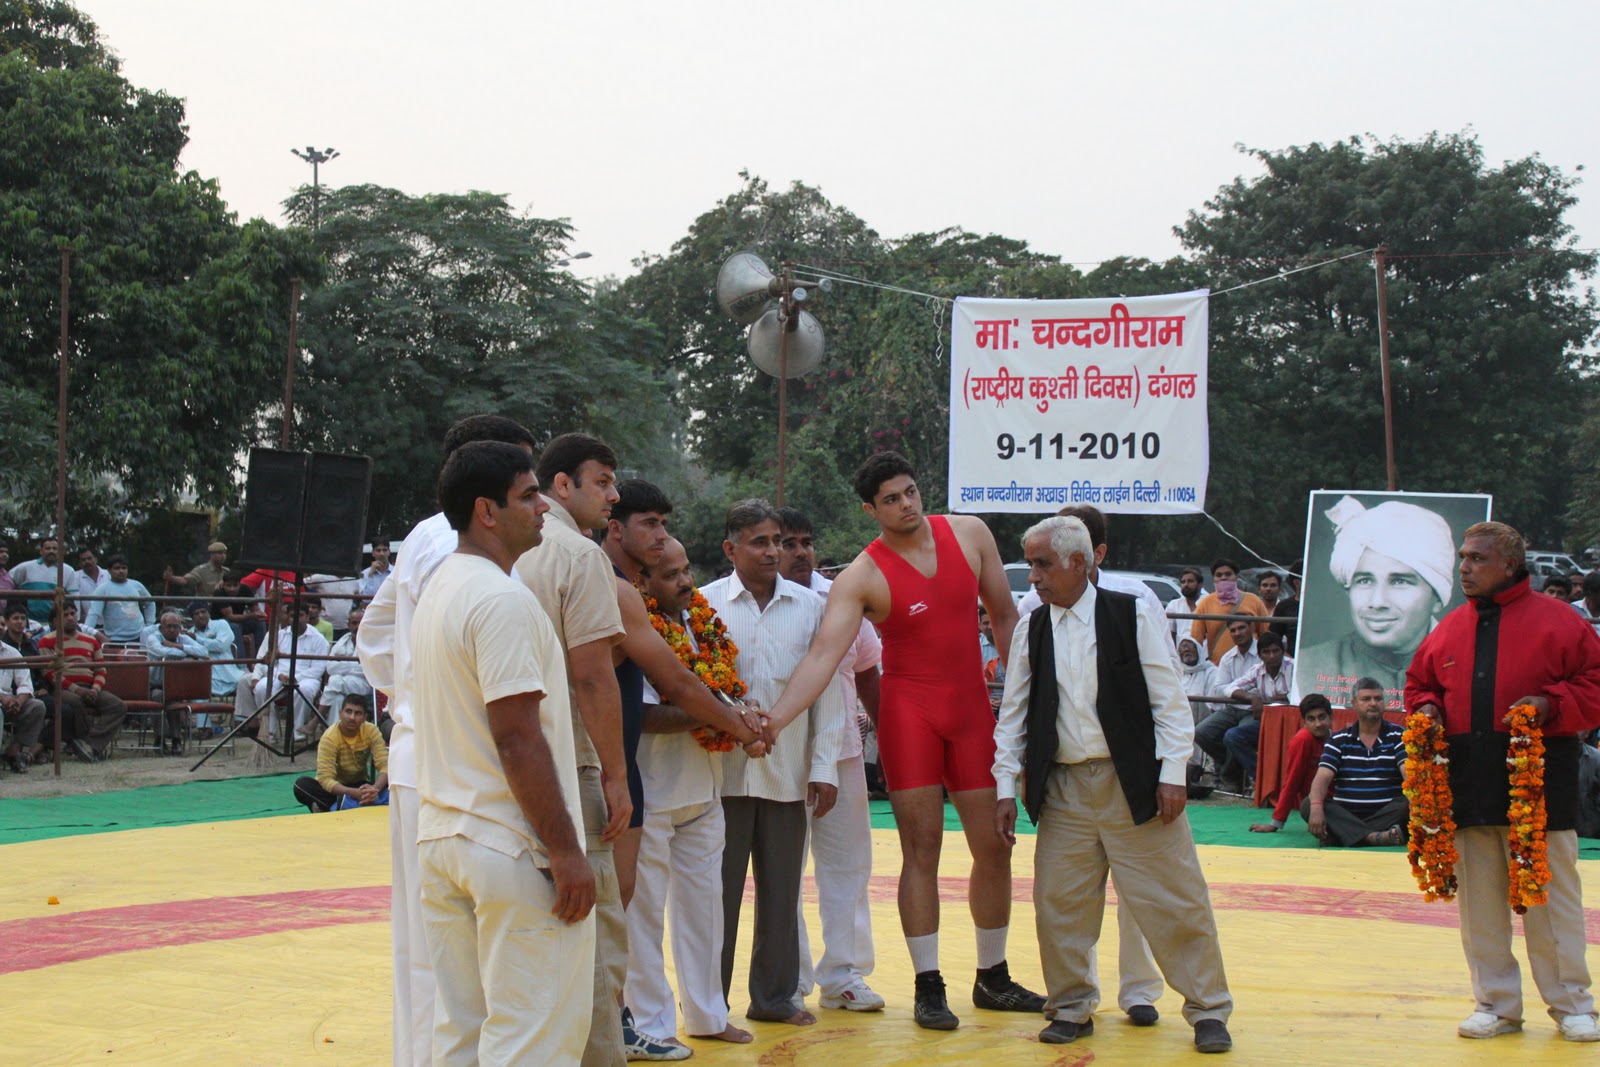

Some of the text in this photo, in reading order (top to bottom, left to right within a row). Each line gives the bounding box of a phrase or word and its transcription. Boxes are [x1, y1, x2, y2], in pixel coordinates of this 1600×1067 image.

[1031, 303, 1186, 349] चन्दगीराम
[1029, 366, 1079, 413] कुश्ती
[1084, 365, 1140, 409] दिवस)
[1148, 365, 1197, 399] दंगल
[996, 432, 1160, 460] 9-11-2010
[960, 486, 985, 502] स्थान
[987, 480, 1034, 503] चन्दगीराम
[1070, 480, 1102, 503] सिविल
[1103, 480, 1130, 505] लाईन
[1133, 479, 1161, 503] दिल्ली
